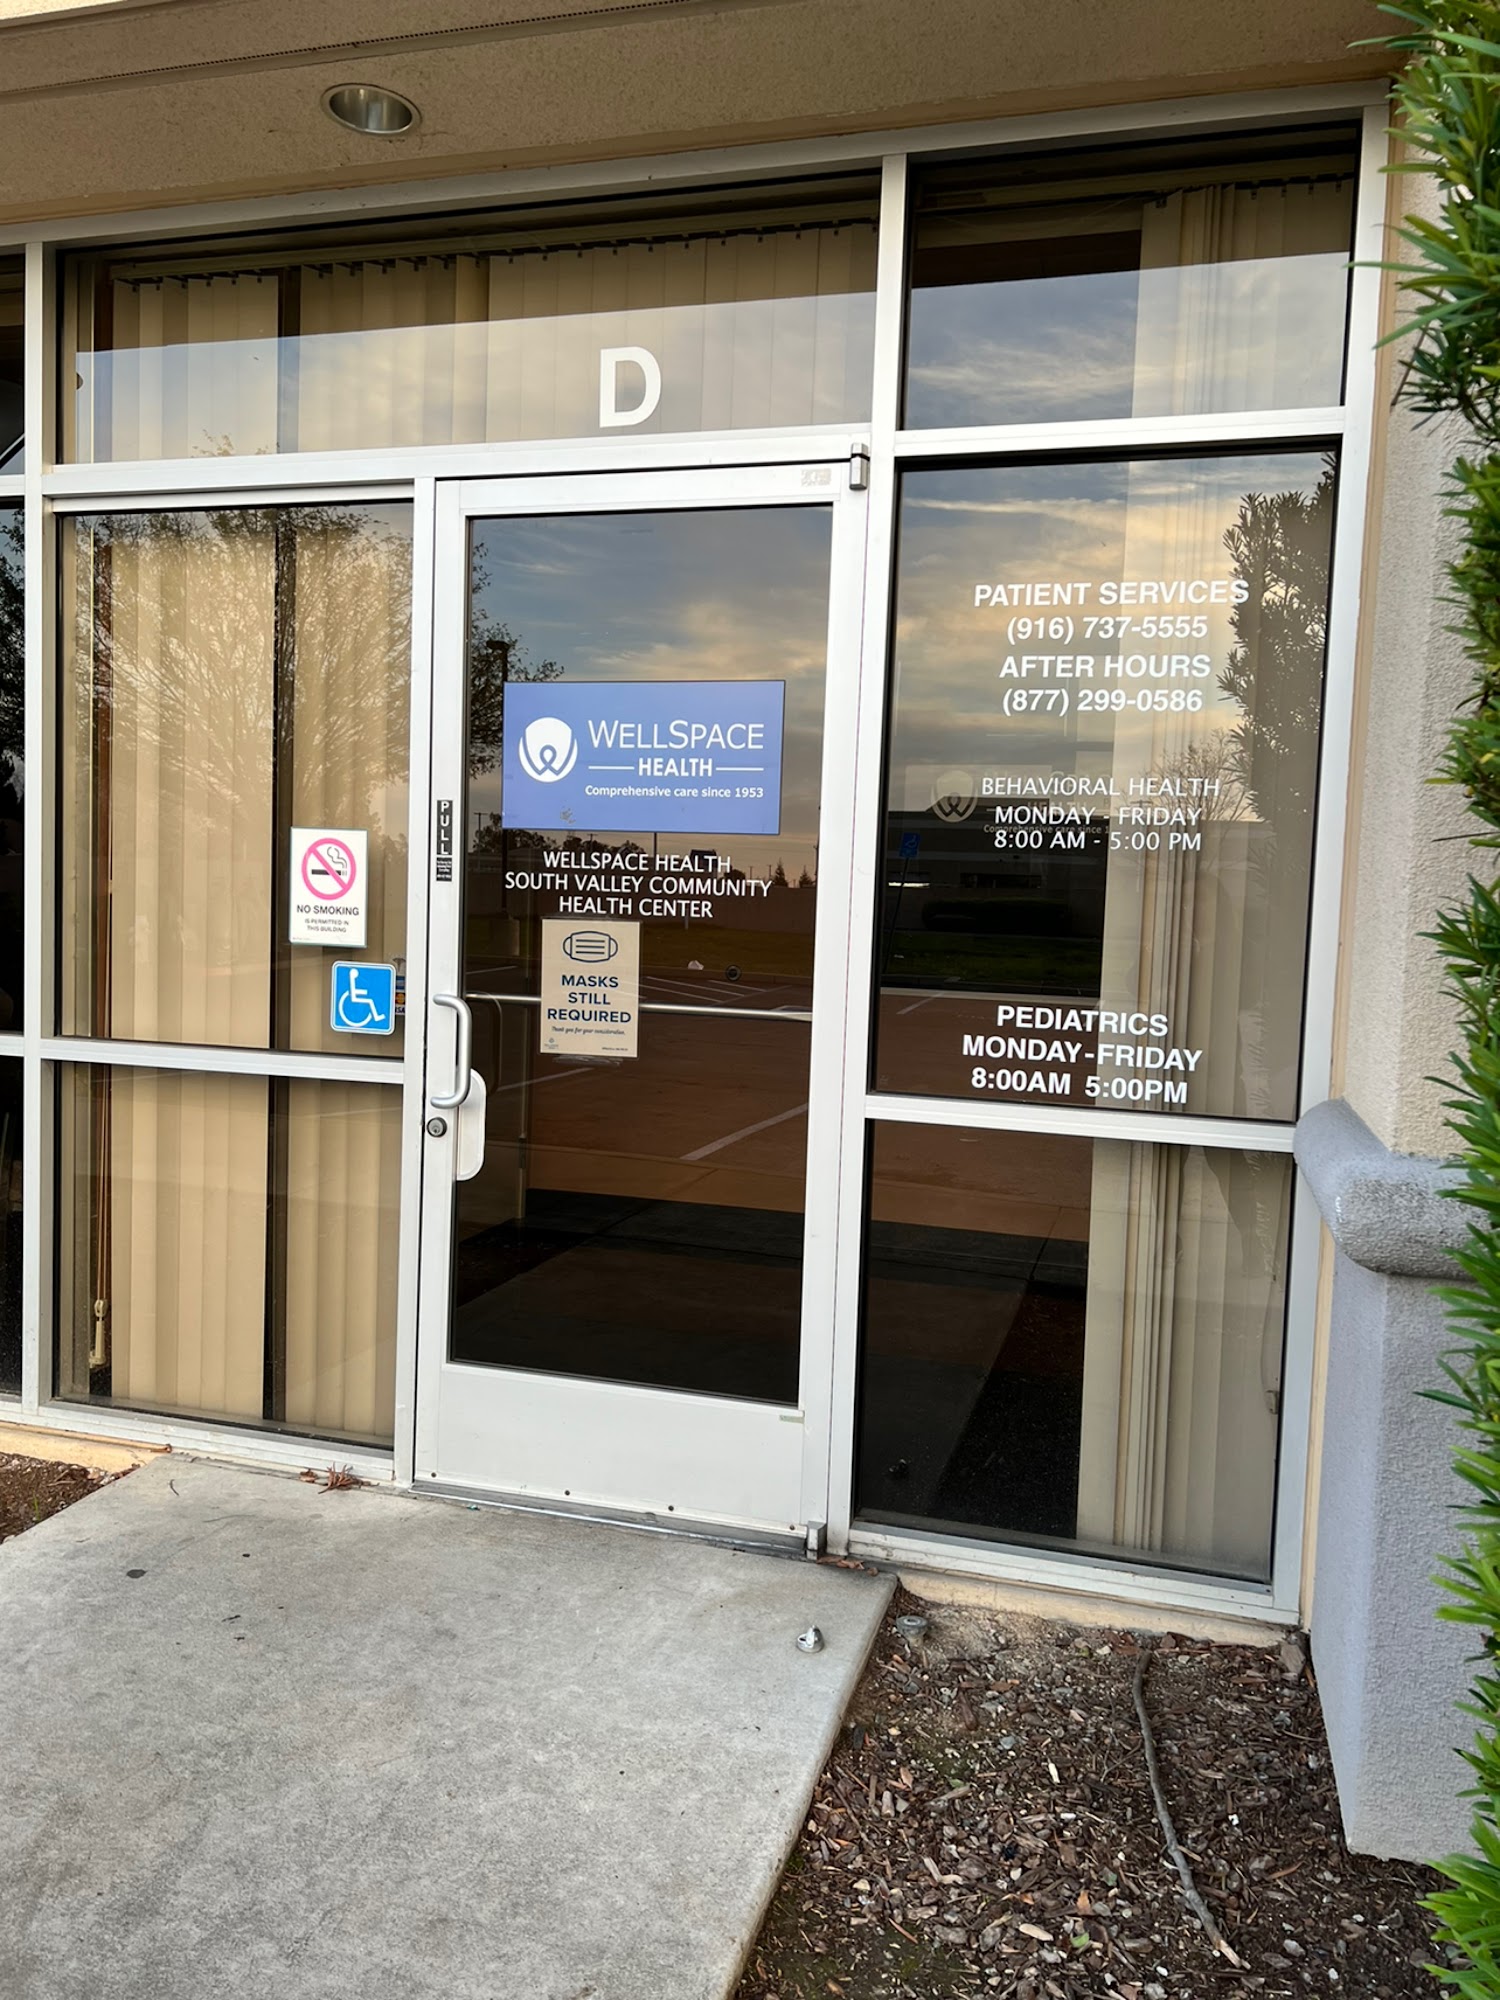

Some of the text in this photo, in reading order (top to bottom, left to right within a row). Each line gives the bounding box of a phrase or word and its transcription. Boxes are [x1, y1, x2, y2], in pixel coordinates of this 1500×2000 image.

[600, 346, 661, 428] D
[974, 580, 1250, 607] PATIENT SERVICES
[1007, 615, 1208, 645] (916) 737-5555
[999, 654, 1211, 678] AFTER HOURS
[1002, 688, 1203, 716] (877) 299-0586
[638, 757, 713, 777] HEALTH
[585, 785, 764, 799] Comprehensive care since 1953
[981, 777, 1120, 796] BEHAVIORAL
[1128, 778, 1220, 797] HEALTH
[994, 806, 1095, 825] MONDAY
[1118, 807, 1202, 826] FRIDAY
[440, 801, 450, 855] PULL
[994, 831, 1043, 849] 8:00
[1049, 832, 1086, 849] AM
[1110, 832, 1160, 850] 5:00
[1168, 833, 1202, 851] PM
[543, 851, 732, 873] WELLSPACE HEALTH
[505, 871, 773, 897] SOUTH VALLEY COMMUNITY
[296, 904, 360, 916] NO SMOKING
[559, 896, 713, 918] HEALTH CENTER
[561, 974, 619, 988] MASKS
[568, 992, 611, 1005] STILL
[547, 1008, 632, 1023] REQUIRED
[997, 1005, 1168, 1037] PEDIATRICS
[971, 1067, 1188, 1104] 8:00AM 5:00PM
